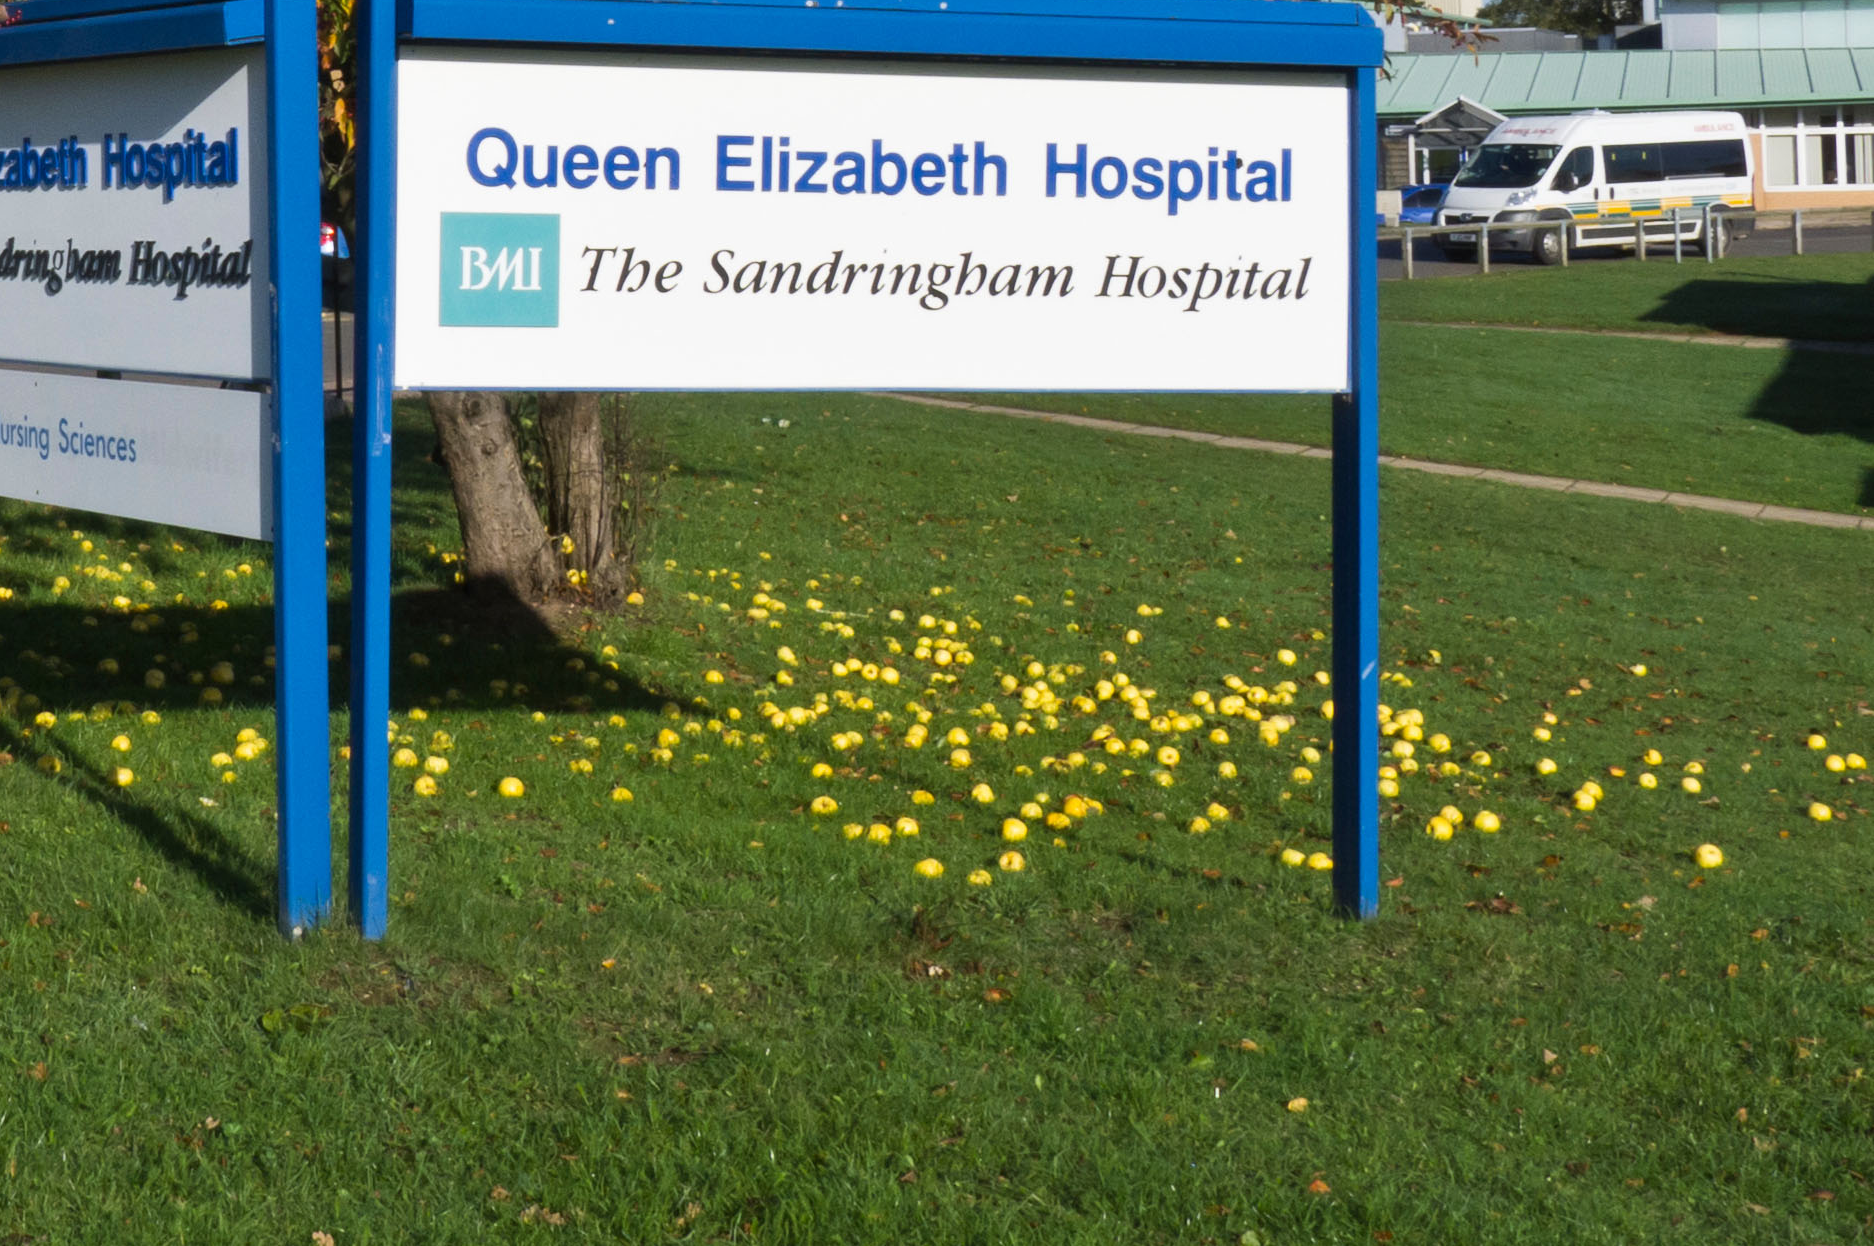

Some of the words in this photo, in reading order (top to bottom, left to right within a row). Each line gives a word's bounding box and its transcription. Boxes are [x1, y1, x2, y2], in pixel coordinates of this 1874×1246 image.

[102, 127, 238, 204] Hospital
[467, 127, 680, 191] Queen
[716, 135, 1007, 197] Elizabeth
[1045, 143, 1293, 216] Hospital
[126, 237, 254, 301] Hospital
[459, 245, 543, 291] BMI
[581, 247, 683, 293] The
[703, 249, 1074, 311] Sandringham
[1095, 255, 1313, 312] Hospital
[58, 417, 137, 464] Sciences
